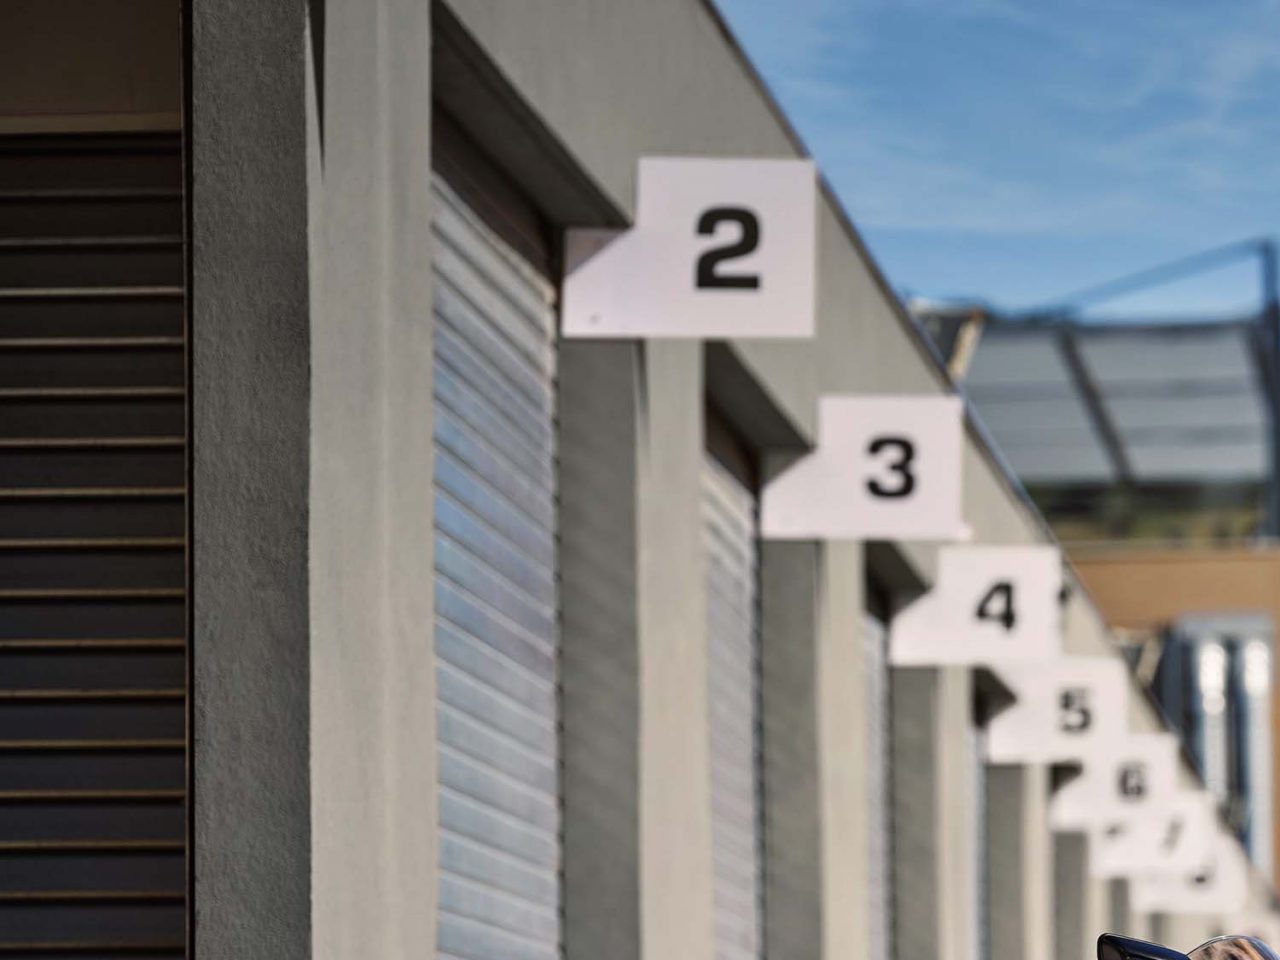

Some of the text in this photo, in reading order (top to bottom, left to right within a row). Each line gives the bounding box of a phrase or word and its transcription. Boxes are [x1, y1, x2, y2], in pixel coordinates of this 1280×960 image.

[695, 207, 761, 290] 2
[865, 438, 917, 498] 3
[976, 582, 1016, 631] 4
[1059, 688, 1091, 732] 5
